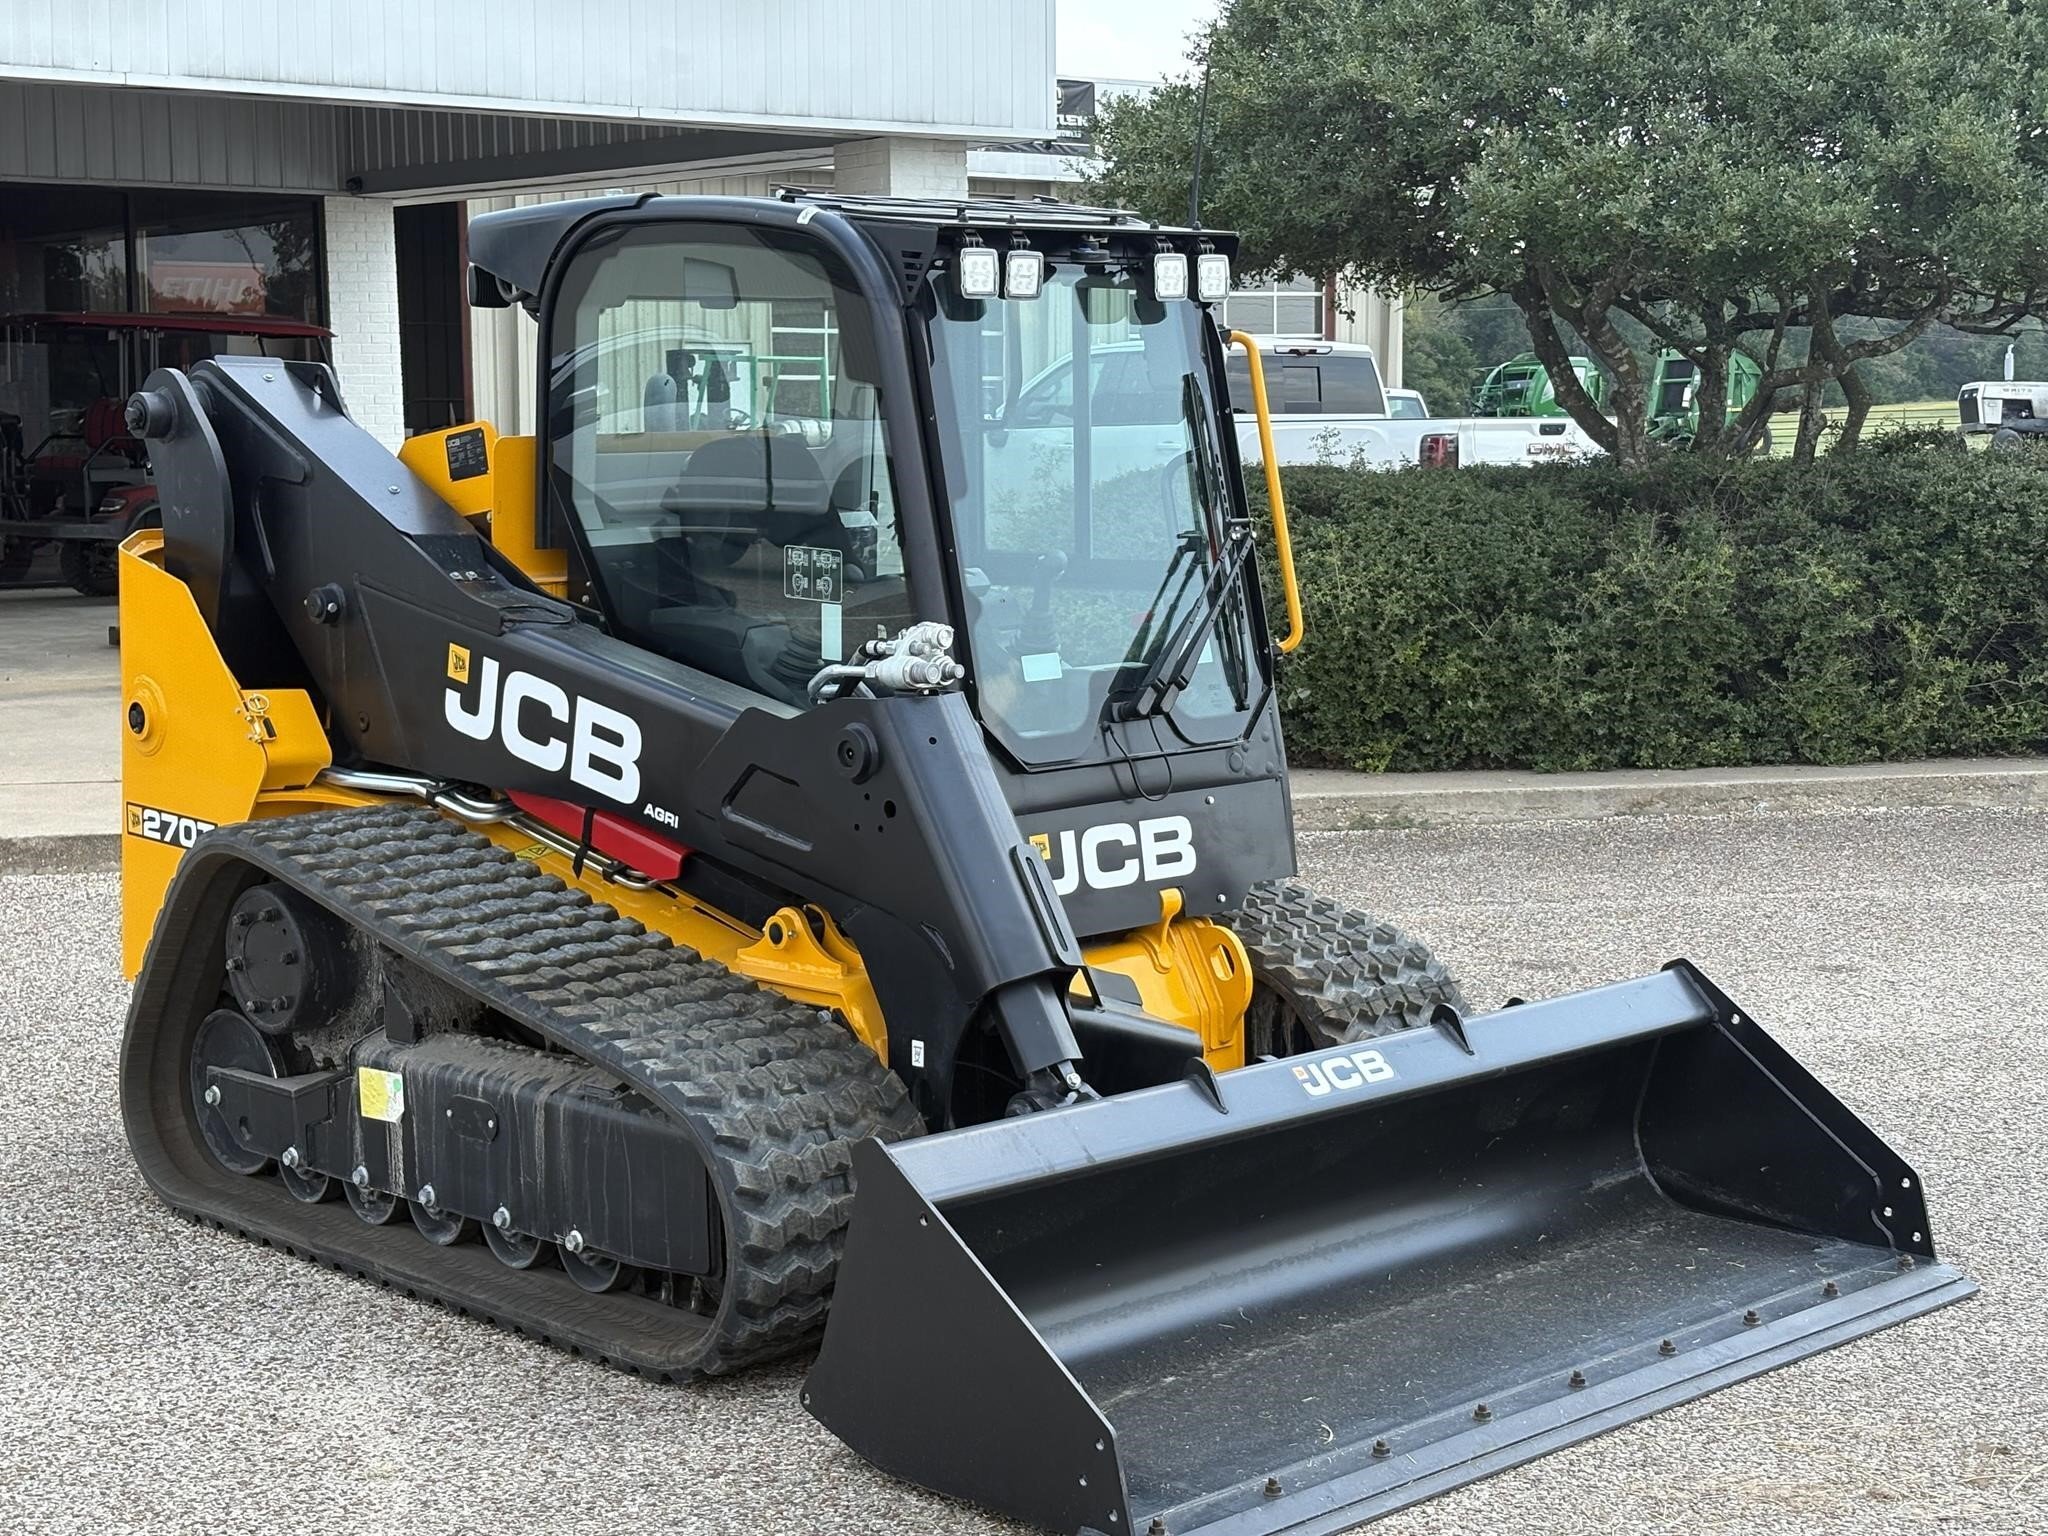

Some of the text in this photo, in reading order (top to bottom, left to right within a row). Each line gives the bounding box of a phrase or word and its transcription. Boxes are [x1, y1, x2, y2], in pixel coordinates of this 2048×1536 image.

[1527, 442, 1577, 456] GMC
[445, 656, 642, 805] JCB
[643, 803, 679, 829] AGRI
[1052, 815, 1197, 896] JCB
[1302, 1050, 1395, 1096] JCB
